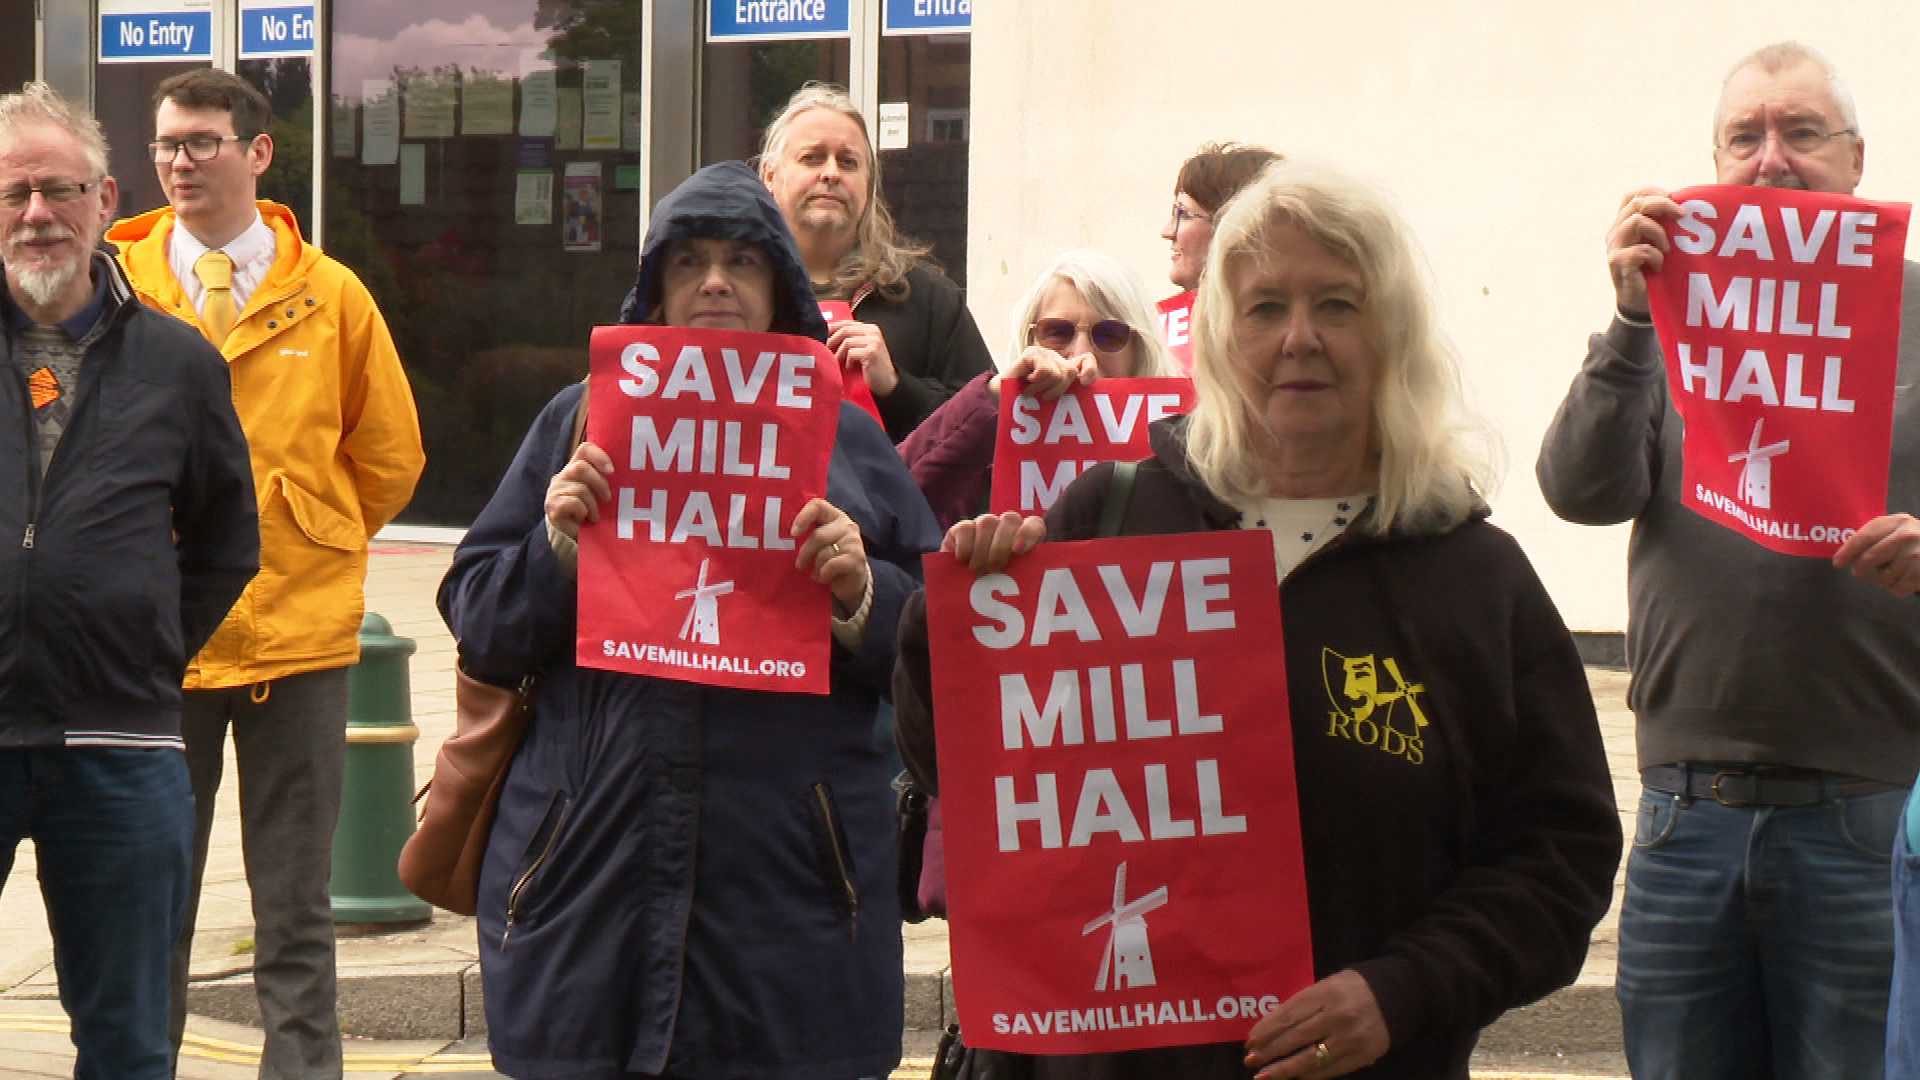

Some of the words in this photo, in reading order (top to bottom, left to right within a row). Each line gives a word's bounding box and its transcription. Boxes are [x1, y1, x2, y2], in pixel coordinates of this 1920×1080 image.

[120, 21, 144, 46] No
[149, 19, 194, 52] Entry
[262, 14, 287, 41] No
[735, 0, 826, 24] Entrance
[1673, 199, 1878, 267] SAVE
[1686, 272, 1851, 339] MILL
[618, 342, 815, 409] SAVE
[1677, 342, 1855, 413] HALL
[630, 415, 791, 479] MILL
[1010, 393, 1181, 445] SAVE
[617, 487, 796, 550] HALL
[969, 557, 1236, 649] SAVE
[602, 639, 806, 678] SAVEMILLHALL.ORG
[999, 658, 1224, 750] MILL
[1326, 710, 1424, 764] RODS
[994, 759, 1247, 852] HALL
[992, 995, 1279, 1035] SAVEMILLHALL.ORG
